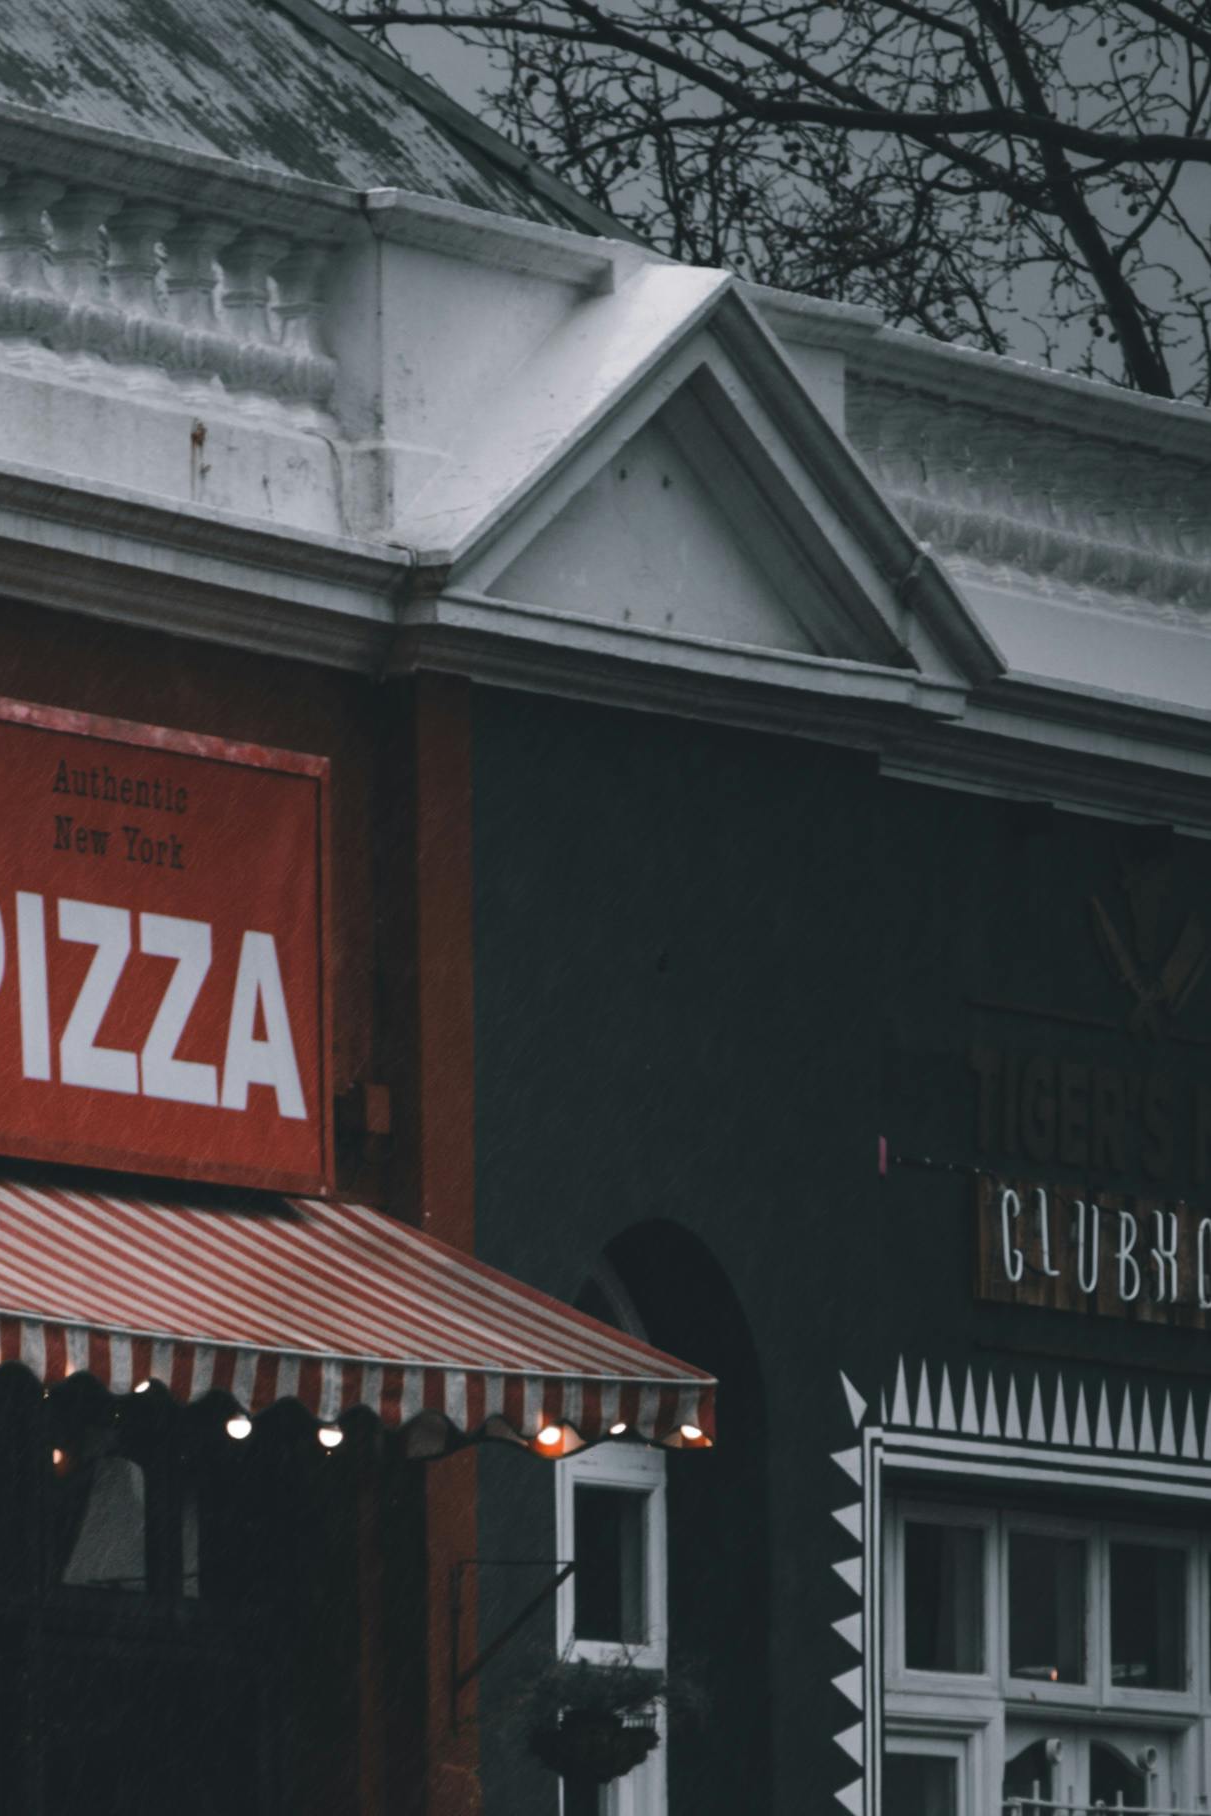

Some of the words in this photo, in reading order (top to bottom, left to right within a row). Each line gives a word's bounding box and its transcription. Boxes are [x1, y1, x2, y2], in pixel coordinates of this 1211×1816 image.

[52, 759, 189, 815] Authentic
[53, 815, 110, 856] New
[122, 826, 185, 870] York
